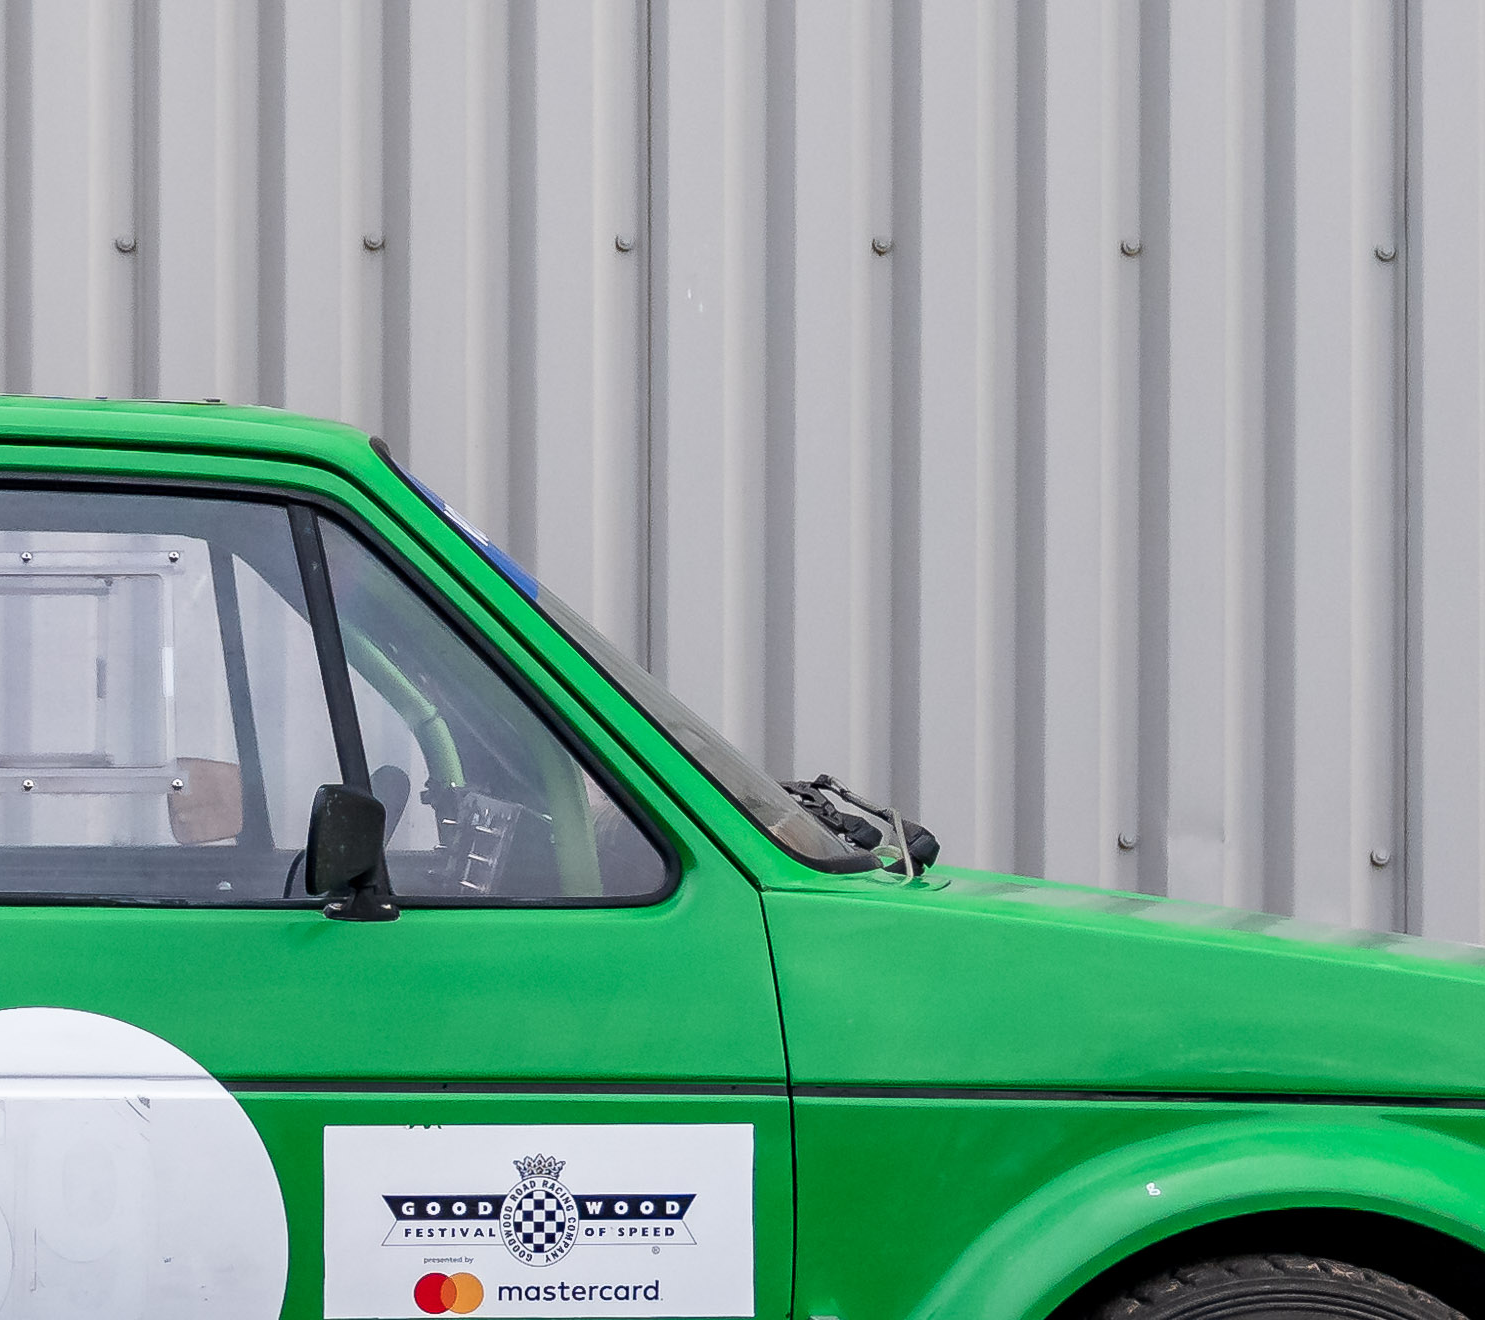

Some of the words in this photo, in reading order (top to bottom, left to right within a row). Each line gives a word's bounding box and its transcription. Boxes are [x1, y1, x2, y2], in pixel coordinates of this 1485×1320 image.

[509, 1180, 536, 1202] ROAD
[541, 1180, 575, 1212] RACING
[404, 1227, 496, 1238] FESTIVAL
[584, 1227, 606, 1237] OF
[618, 1227, 675, 1237] SPEED
[503, 1205, 533, 1262] GOODWOOD
[545, 1216, 577, 1263] COMPANY
[423, 1256, 463, 1264] presented
[464, 1256, 474, 1264] by
[497, 1279, 660, 1301] mastercard
